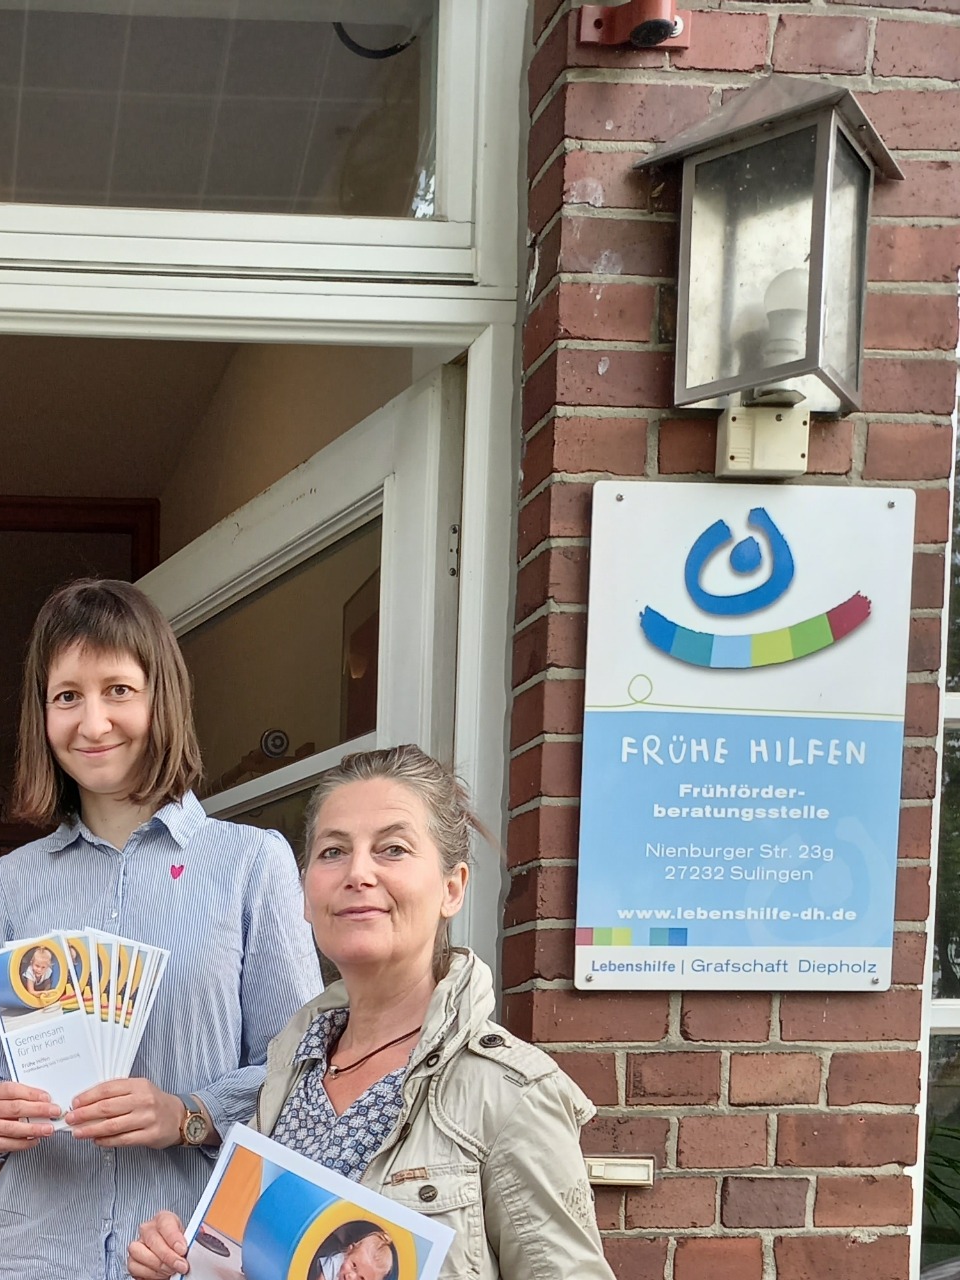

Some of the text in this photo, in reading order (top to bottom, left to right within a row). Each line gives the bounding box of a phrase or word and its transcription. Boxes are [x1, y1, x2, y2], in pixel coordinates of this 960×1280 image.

[620, 734, 866, 766] FRÜHE HILFEN
[678, 783, 806, 799] Frühförder-
[653, 803, 830, 822] beratungsstelle
[645, 842, 834, 862] Nienburger Str. 23g
[664, 865, 814, 884] 27232 Sulingen
[616, 906, 857, 922] www.lebenshilfe-dh.de
[591, 958, 877, 976] Lebenshilfe Grafschaft Diepholz
[14, 1026, 65, 1047] Gemeinsam
[17, 1047, 30, 1057] für
[44, 1035, 66, 1049] Kind!
